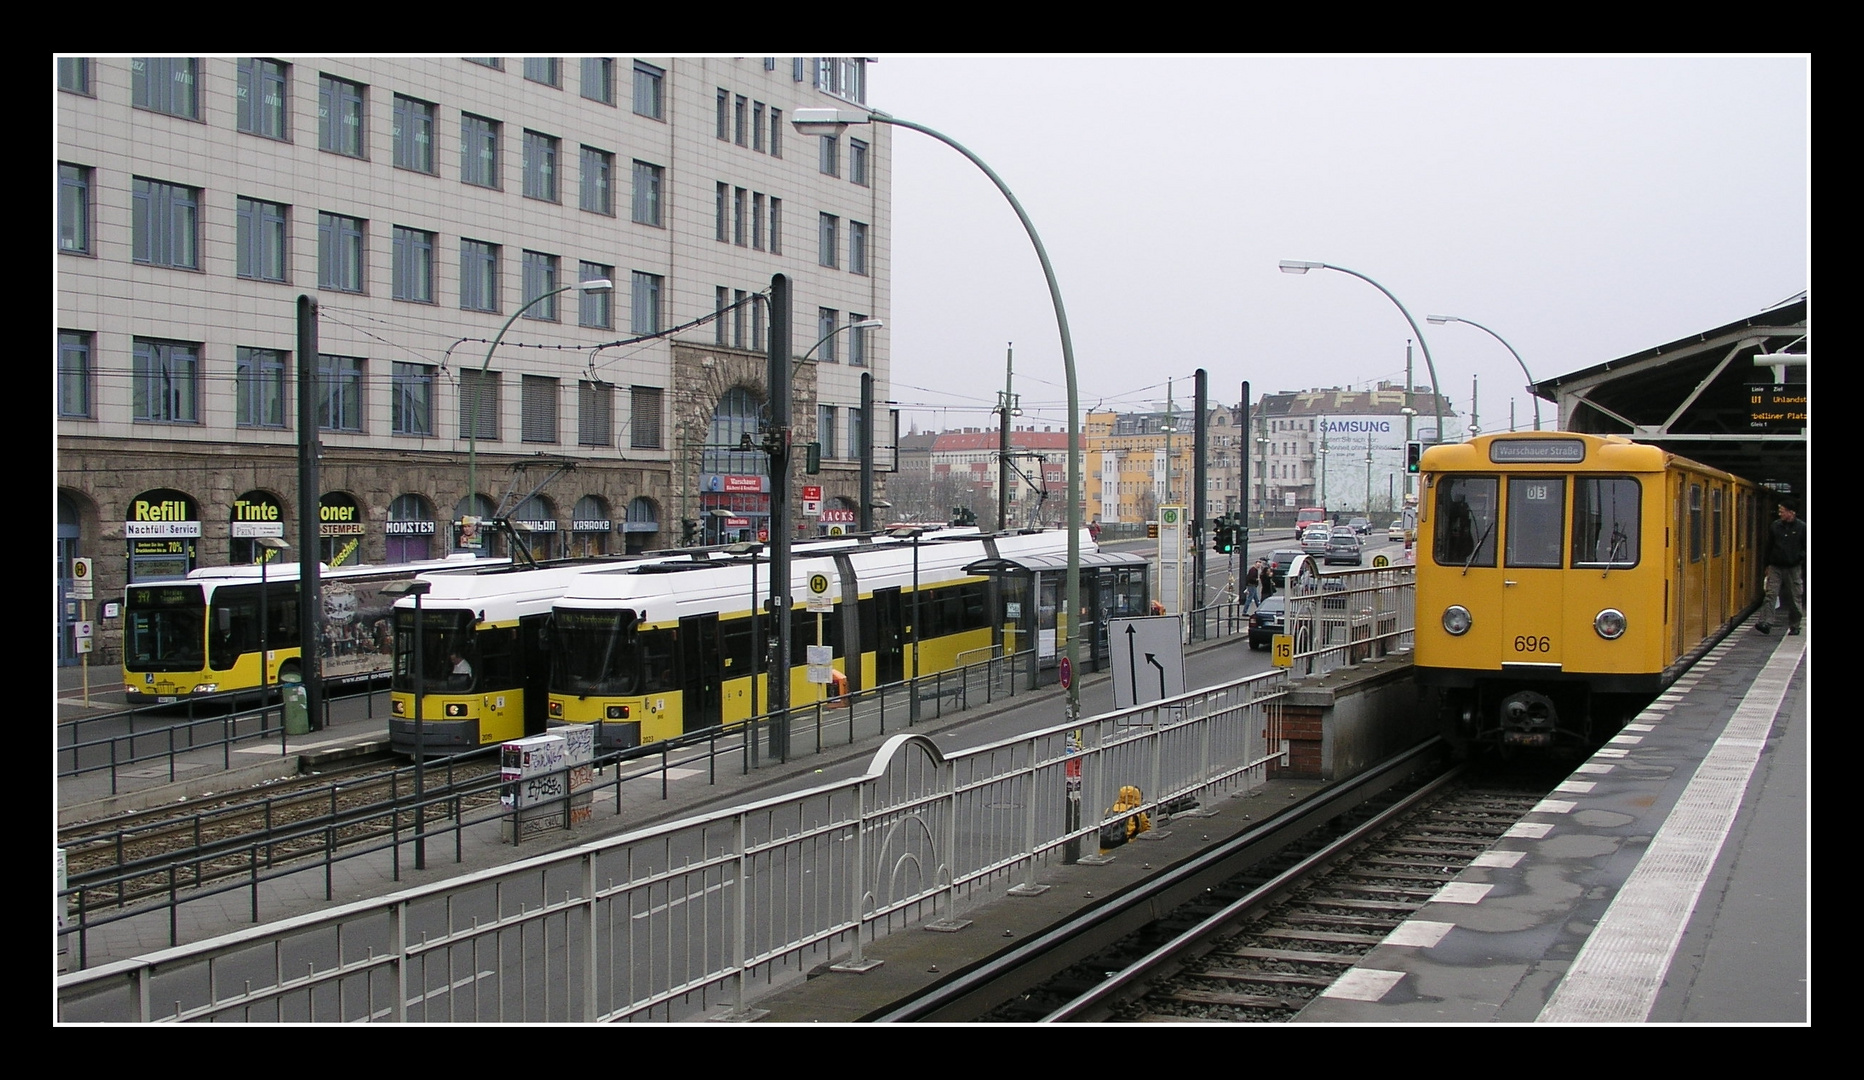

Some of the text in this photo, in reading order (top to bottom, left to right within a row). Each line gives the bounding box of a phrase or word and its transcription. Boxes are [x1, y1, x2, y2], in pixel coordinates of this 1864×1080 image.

[1751, 395, 1761, 404] U1
[1319, 421, 1390, 433] SAMSUNG
[1500, 446, 1578, 456] Warschauer Straße
[135, 500, 186, 521] Refill
[235, 500, 278, 521] Tinte
[319, 501, 354, 521] oner
[820, 510, 854, 522] NACKS
[573, 520, 610, 530] KARAOKE
[168, 541, 183, 553] 70%
[1513, 635, 1551, 653] 696
[1276, 644, 1290, 658] 15
